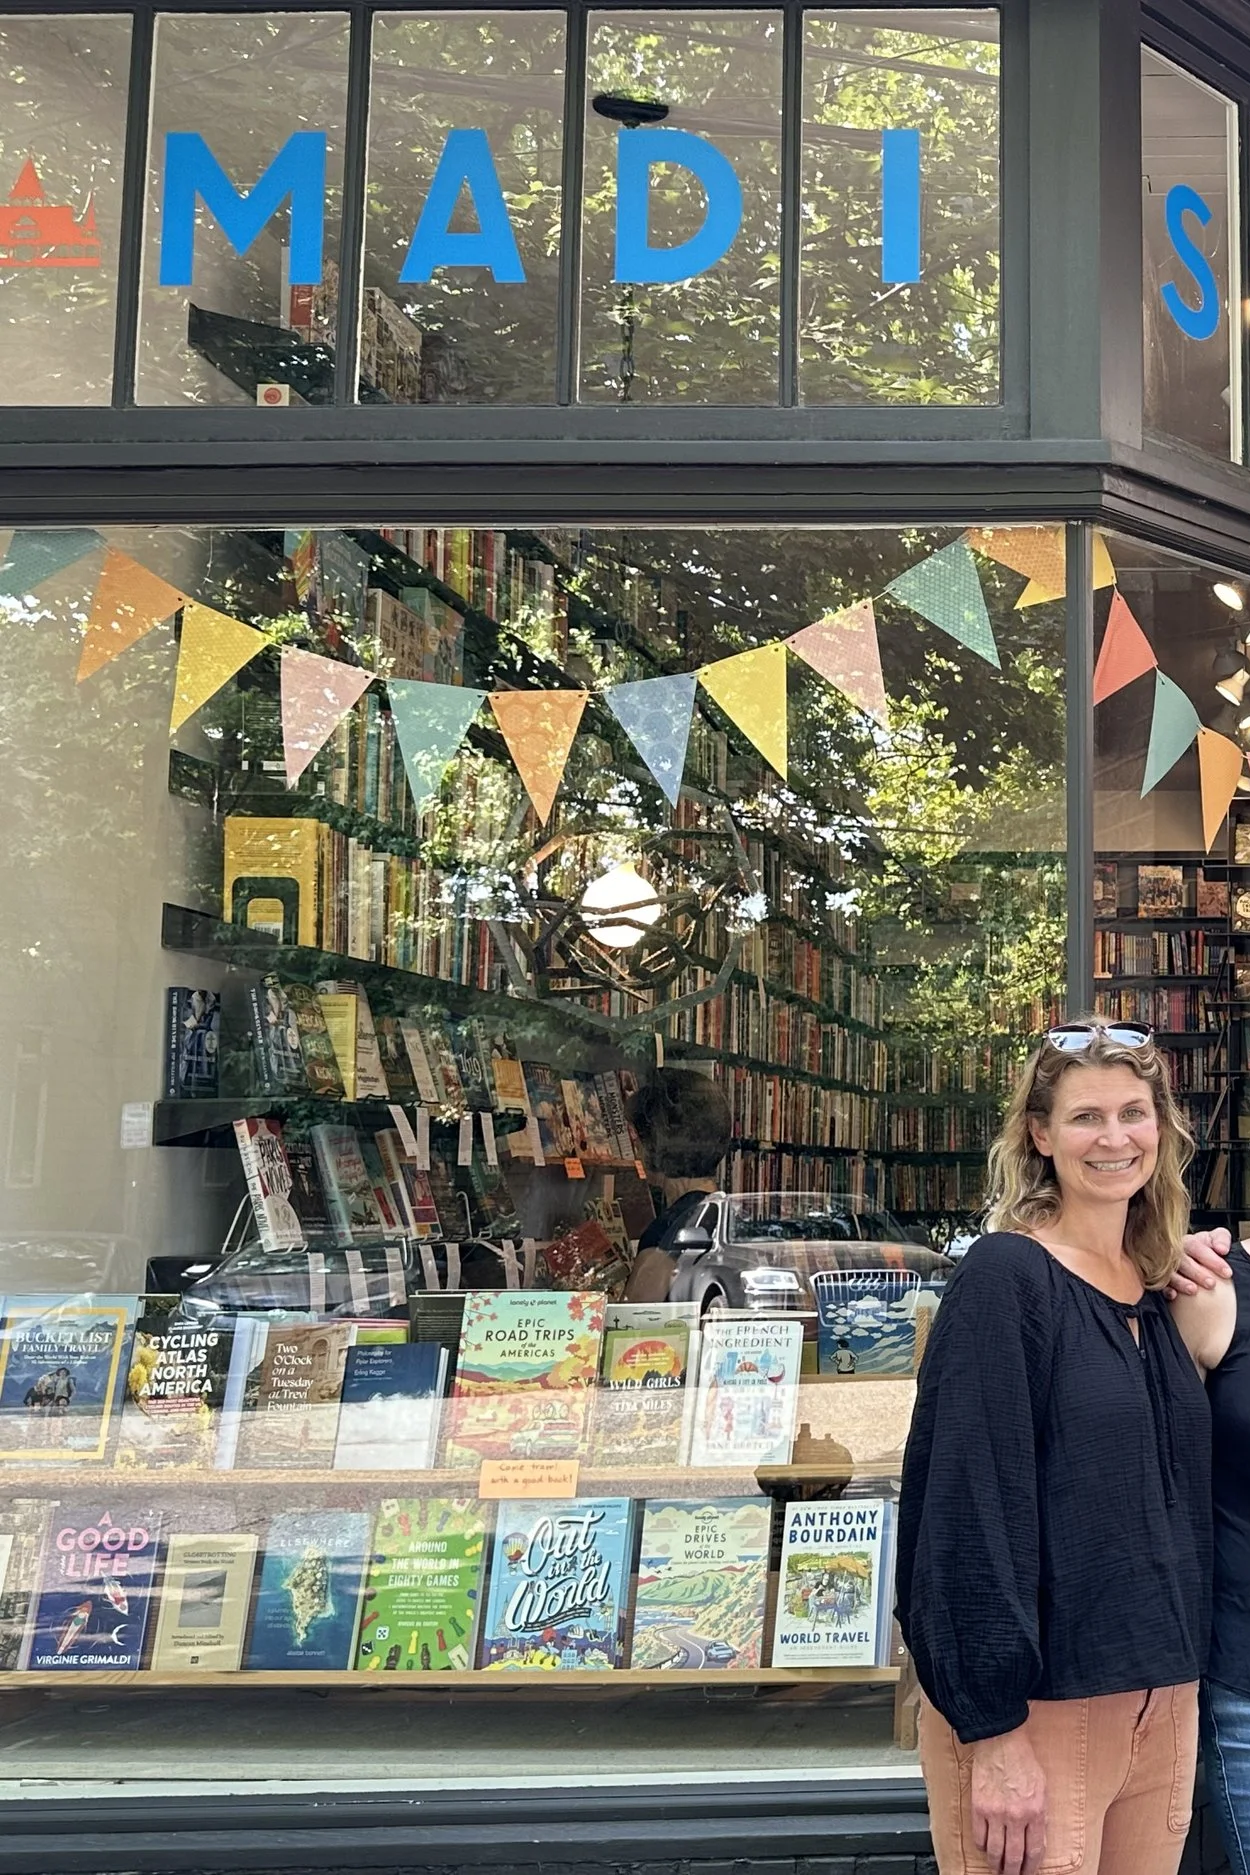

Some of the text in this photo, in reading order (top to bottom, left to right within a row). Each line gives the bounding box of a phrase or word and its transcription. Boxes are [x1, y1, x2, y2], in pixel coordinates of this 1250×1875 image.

[608, 1091, 626, 1135] MONSTERS
[510, 1299, 558, 1308] lonely planet
[517, 1318, 546, 1328] EPIC
[485, 1329, 575, 1342] ROAD TRIPS
[714, 1324, 790, 1336] THE FRENCH
[16, 1332, 112, 1344] BUCKET LIST
[150, 1332, 219, 1350] CYCLING
[710, 1338, 793, 1348] INGREDIENT
[22, 1344, 101, 1352] FAMILY TRAVEL
[276, 1344, 298, 1353] Two
[500, 1349, 556, 1358] AMERICAS
[156, 1348, 208, 1364] ATLAS
[274, 1356, 312, 1365] O'Clock
[151, 1364, 208, 1380] NORTH
[139, 1379, 212, 1396] AMERICA
[271, 1378, 314, 1389] Tuesday
[609, 1376, 681, 1390] WILD GIRLS
[268, 1390, 308, 1400] at Trevi
[267, 1401, 312, 1412] Fountain
[499, 1463, 524, 1472] Come
[522, 1475, 544, 1488] good
[98, 1510, 114, 1527] A
[791, 1510, 879, 1527] ANTHONY
[695, 1525, 718, 1534] EPIC
[788, 1526, 877, 1544] BOURDAIN
[56, 1527, 150, 1551] GOOD
[280, 1538, 350, 1548] ELSEWHERE
[520, 1510, 606, 1576] Out
[684, 1533, 727, 1544] DRIVES
[408, 1541, 448, 1553] AROUND
[580, 1548, 603, 1570] the
[684, 1550, 725, 1560] WORLD
[65, 1553, 130, 1577] LIFE
[392, 1558, 460, 1570] THE WORLD IN
[546, 1560, 571, 1580] in
[388, 1574, 460, 1588] EIGHTY GAMES
[504, 1560, 612, 1632] World
[780, 1632, 870, 1644] WORLD TRAVEL
[36, 1654, 131, 1665] VIRGINIE GRIMALDI
